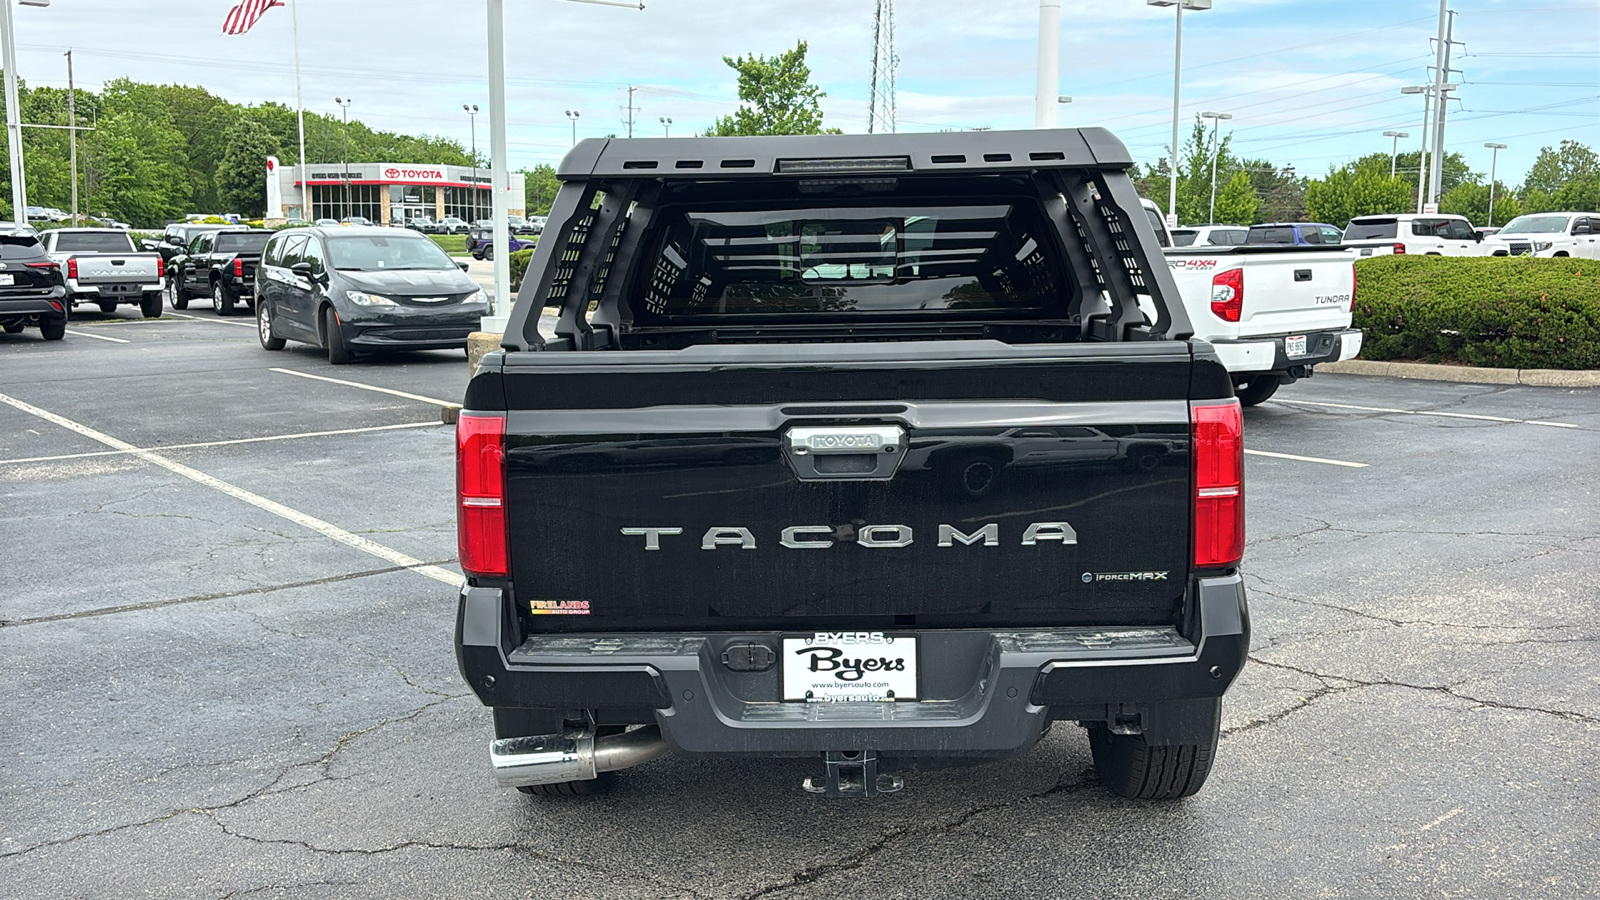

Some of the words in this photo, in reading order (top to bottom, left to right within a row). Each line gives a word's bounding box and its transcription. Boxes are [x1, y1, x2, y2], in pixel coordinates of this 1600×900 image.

[401, 170, 442, 179] TOYOTA
[1315, 294, 1350, 304] TUNDRA
[816, 435, 875, 447] TOYOTA
[619, 523, 1078, 550] TACOMA
[529, 600, 590, 610] FIRELANDS
[814, 631, 884, 645] BYERS
[795, 646, 905, 681] Byers
[811, 681, 889, 690] www.byersauto.com
[806, 692, 895, 704] www.byersauto.com
